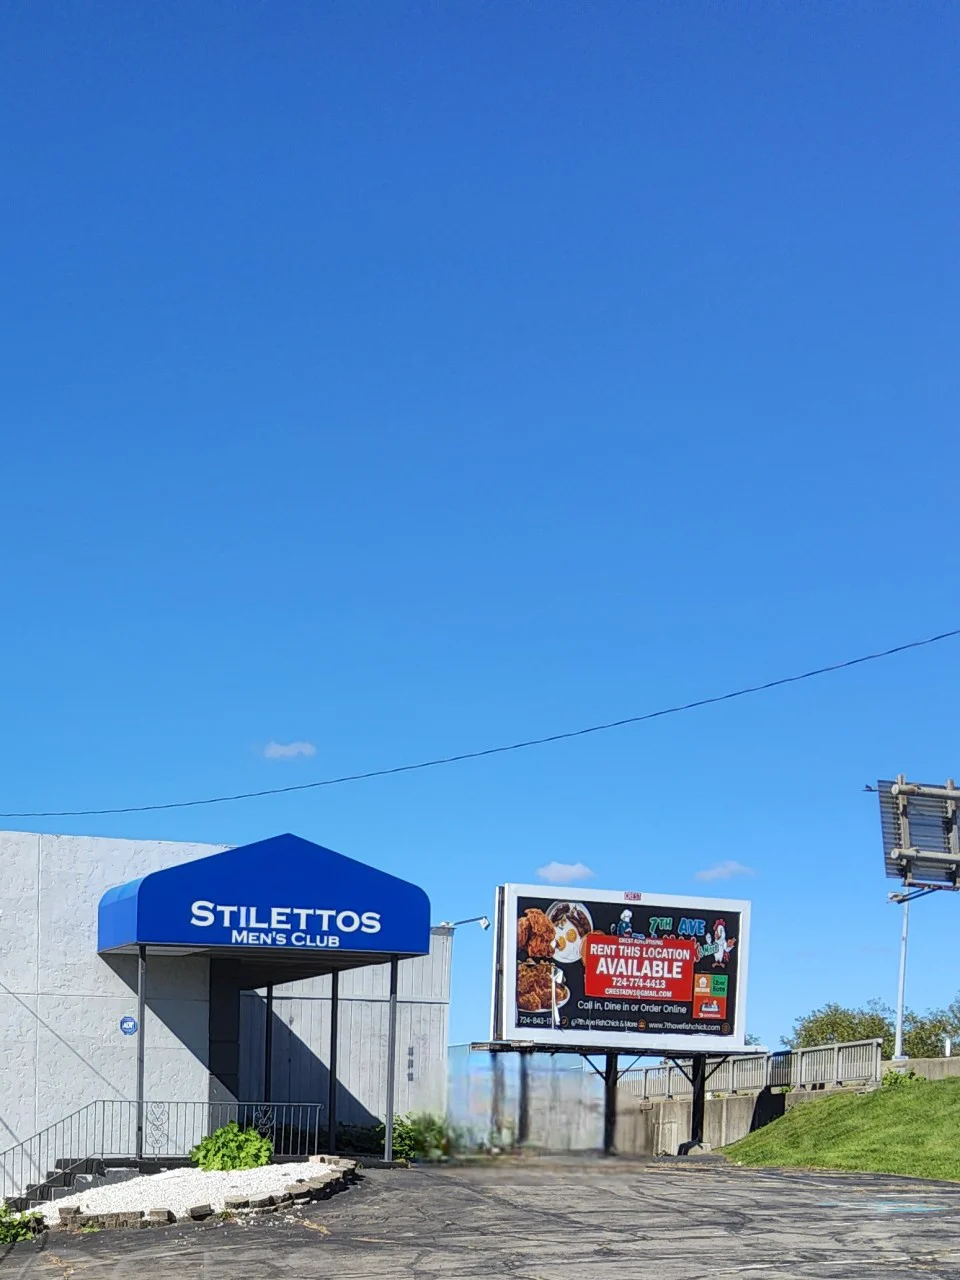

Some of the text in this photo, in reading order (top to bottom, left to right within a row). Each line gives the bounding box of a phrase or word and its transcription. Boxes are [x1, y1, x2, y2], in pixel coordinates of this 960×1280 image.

[624, 892, 642, 901] CREST
[190, 900, 382, 934] STILETTOS
[648, 916, 706, 936] 7TH AVE
[231, 930, 340, 948] MEN'S CLUB
[634, 938, 664, 946] ADVERTISING
[590, 943, 690, 960] RENT THIS LOCATION
[596, 957, 683, 979] AVAILABLE
[611, 977, 666, 989] 724-774-4413
[577, 1001, 593, 1010] Call
[594, 1002, 603, 1011] in,
[604, 1002, 621, 1011] Dine
[622, 1002, 630, 1011] in
[640, 1003, 662, 1012] Order
[663, 1004, 687, 1014] Online
[122, 1021, 135, 1029] ADT
[586, 1018, 596, 1026] Ave
[624, 1020, 638, 1028] More
